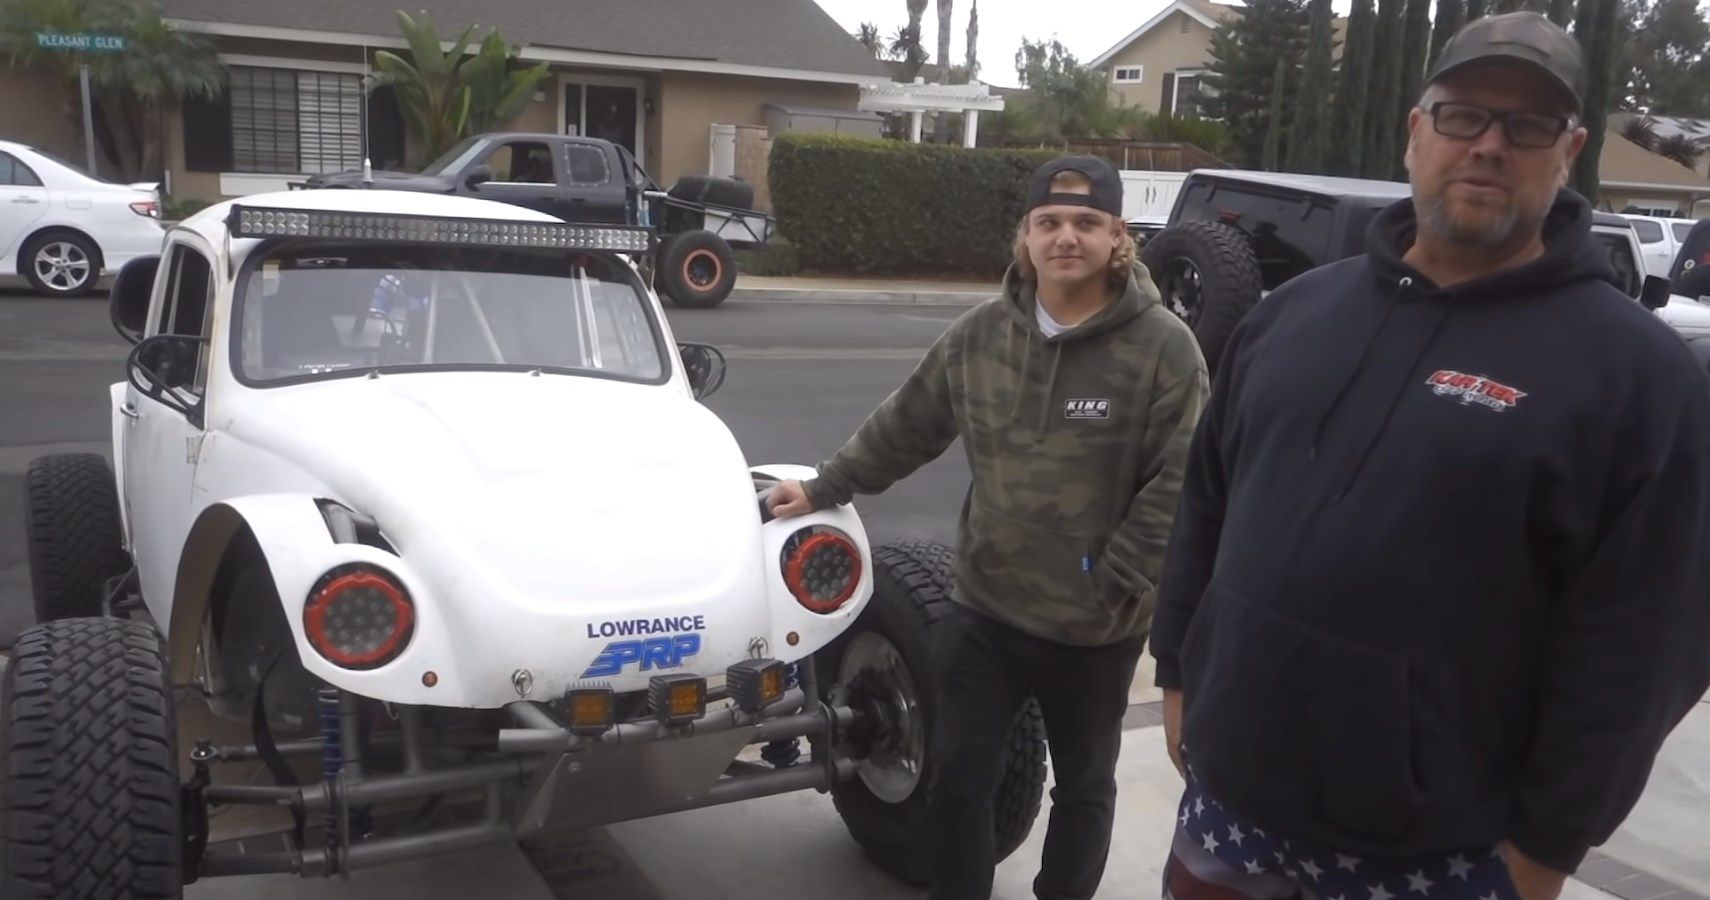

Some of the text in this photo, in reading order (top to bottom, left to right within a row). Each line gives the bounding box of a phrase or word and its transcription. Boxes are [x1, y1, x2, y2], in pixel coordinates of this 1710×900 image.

[38, 34, 123, 49] PLEASANT GLEN
[1067, 401, 1108, 410] KING
[587, 615, 706, 638] LOWRANCE
[579, 633, 701, 678] PRP
